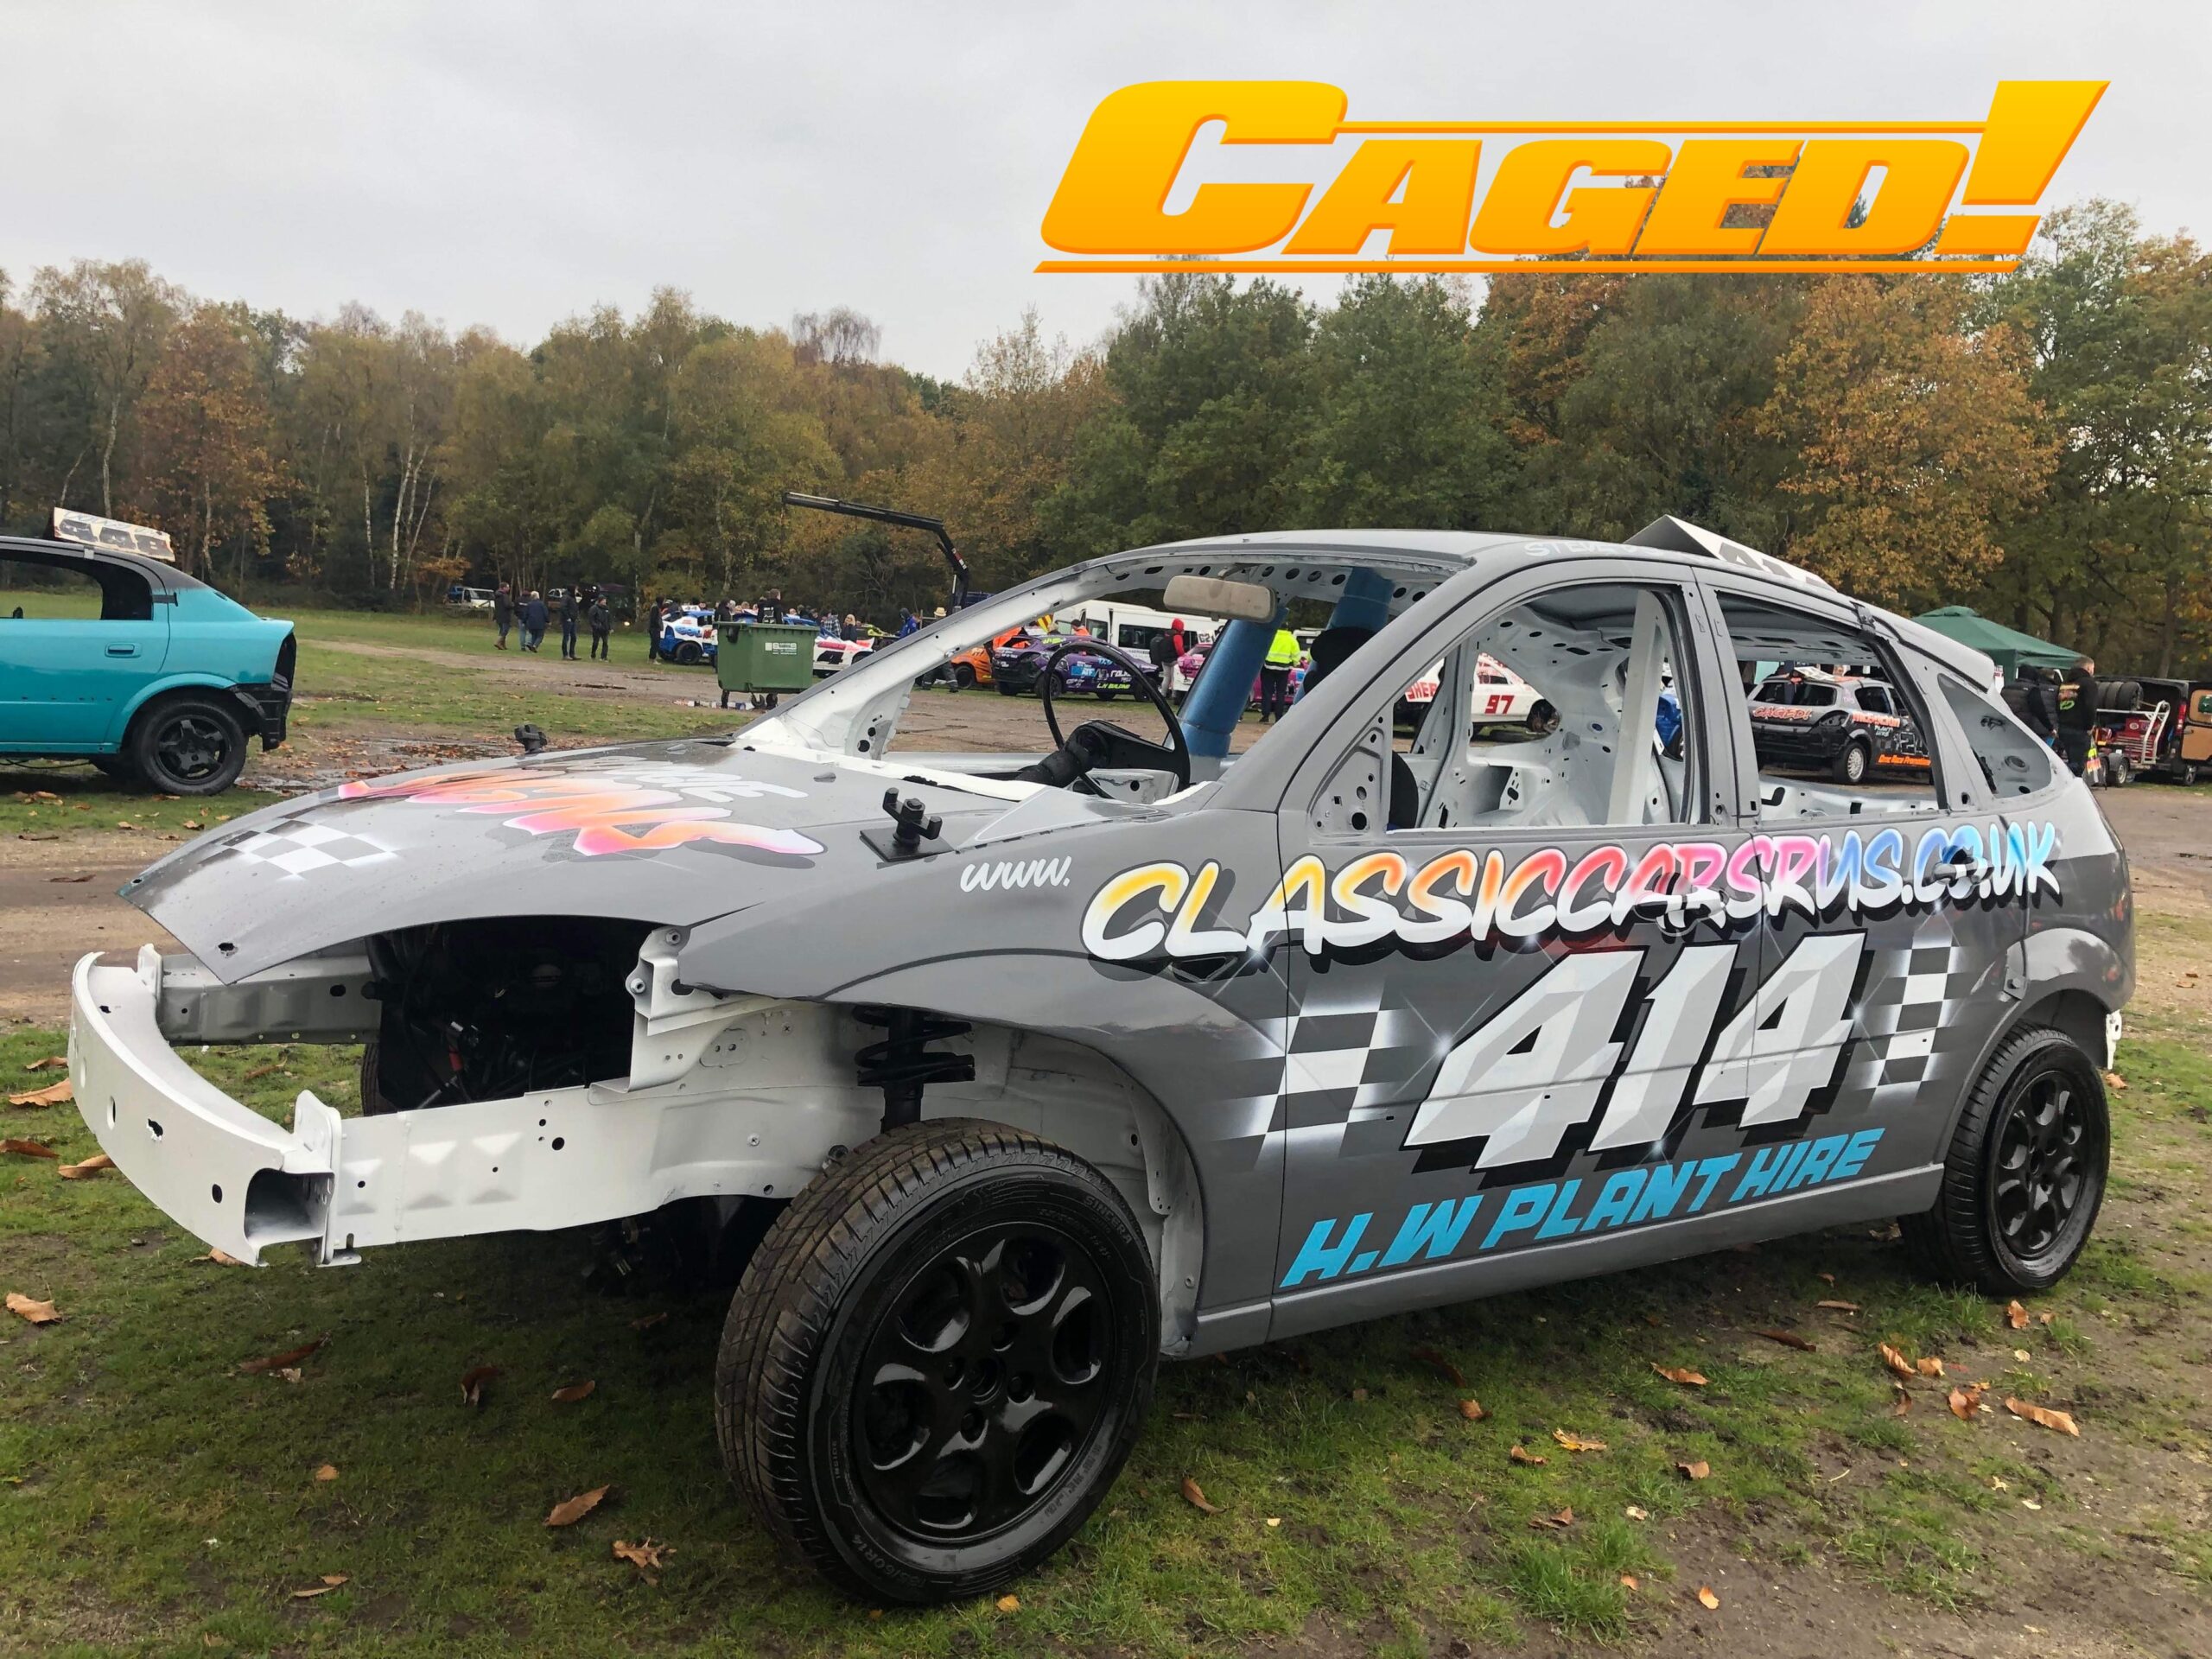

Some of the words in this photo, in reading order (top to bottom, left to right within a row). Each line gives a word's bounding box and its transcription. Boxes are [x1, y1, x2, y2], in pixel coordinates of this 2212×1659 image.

[1484, 694, 1515, 715] 97
[1753, 706, 1812, 721] CAGED!
[959, 855, 1072, 893] www.
[1082, 820, 2062, 961] CLASSICCARSRUS.CO.UK
[1403, 931, 1867, 1169] 414
[1279, 1195, 1471, 1288] H.W
[1479, 1152, 1740, 1249] PLANT
[1729, 1128, 1885, 1203] HIRE
